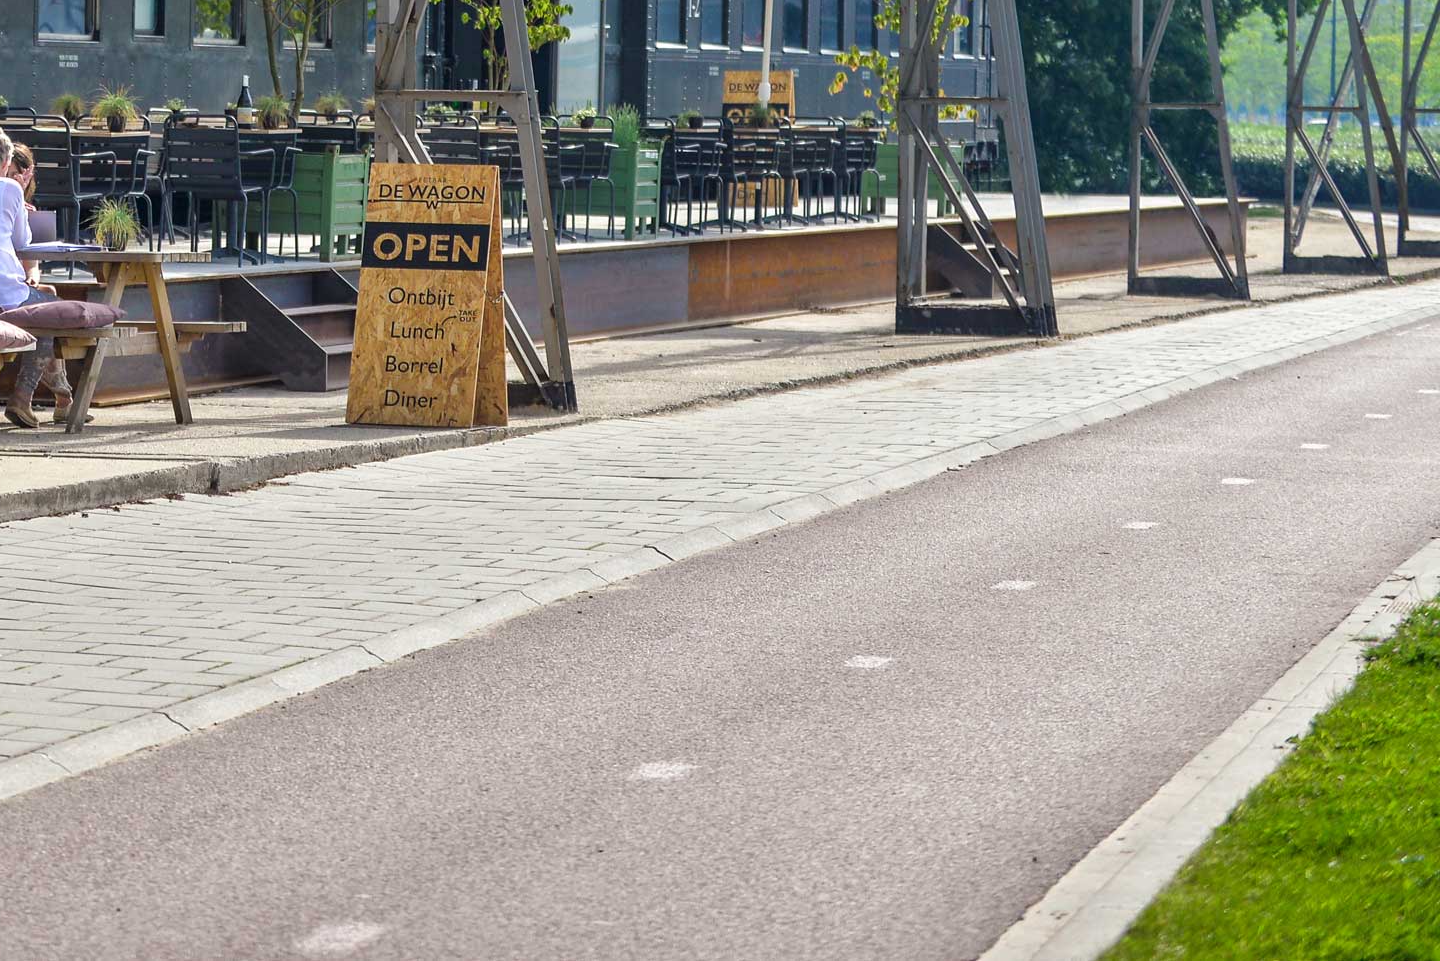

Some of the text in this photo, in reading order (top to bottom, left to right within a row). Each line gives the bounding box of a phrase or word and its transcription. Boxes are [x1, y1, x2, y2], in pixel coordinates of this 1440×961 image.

[379, 184, 485, 200] DE WAGON
[372, 232, 482, 263] OPEN
[388, 286, 455, 308] Ontbijt
[390, 321, 445, 339] Lunch
[385, 355, 444, 374] Borrel
[383, 389, 437, 408] Diner
